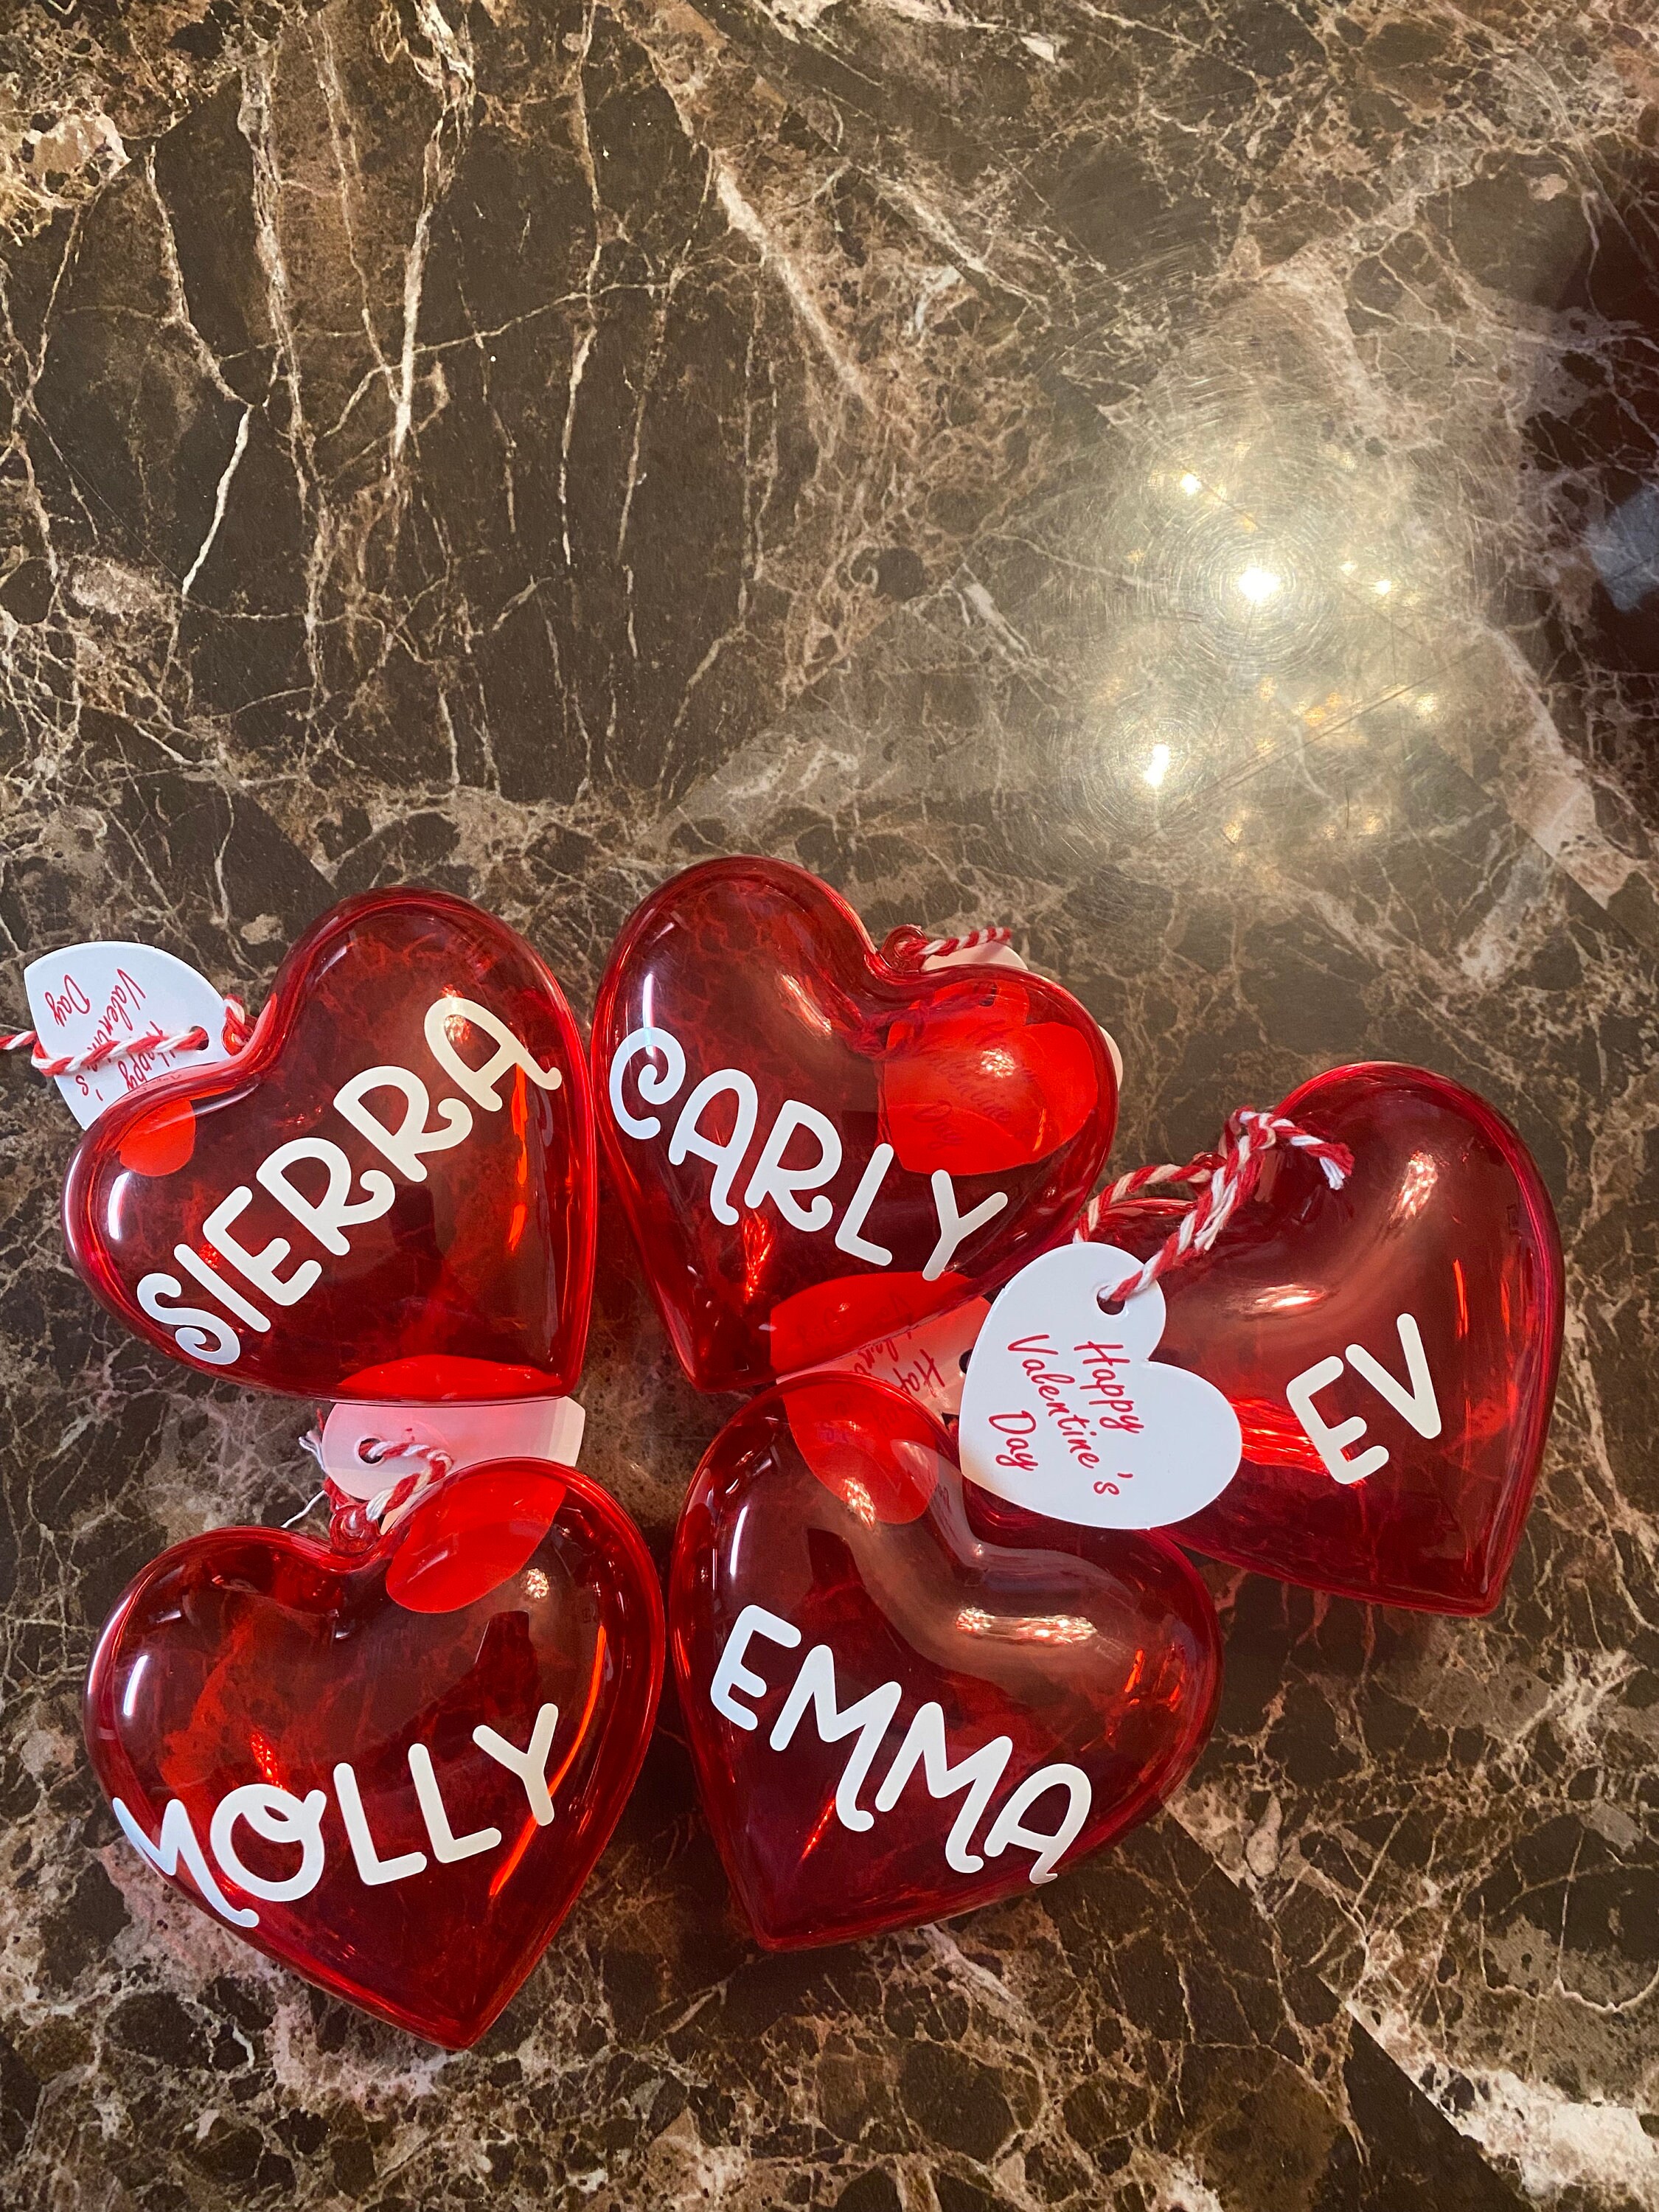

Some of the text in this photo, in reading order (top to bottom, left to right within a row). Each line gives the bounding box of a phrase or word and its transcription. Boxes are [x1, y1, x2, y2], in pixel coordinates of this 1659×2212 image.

[44, 974, 91, 1027] Day
[136, 997, 563, 1366] SIERRA
[609, 1027, 1009, 1281] CARLY
[988, 1410, 1039, 1472] Day
[1007, 1334, 1134, 1496] Valentine's
[1074, 1340, 1144, 1434] Happy
[1286, 1312, 1443, 1486] EV
[112, 1703, 560, 1929] MOLLY
[710, 1604, 1094, 1885] EMMA
